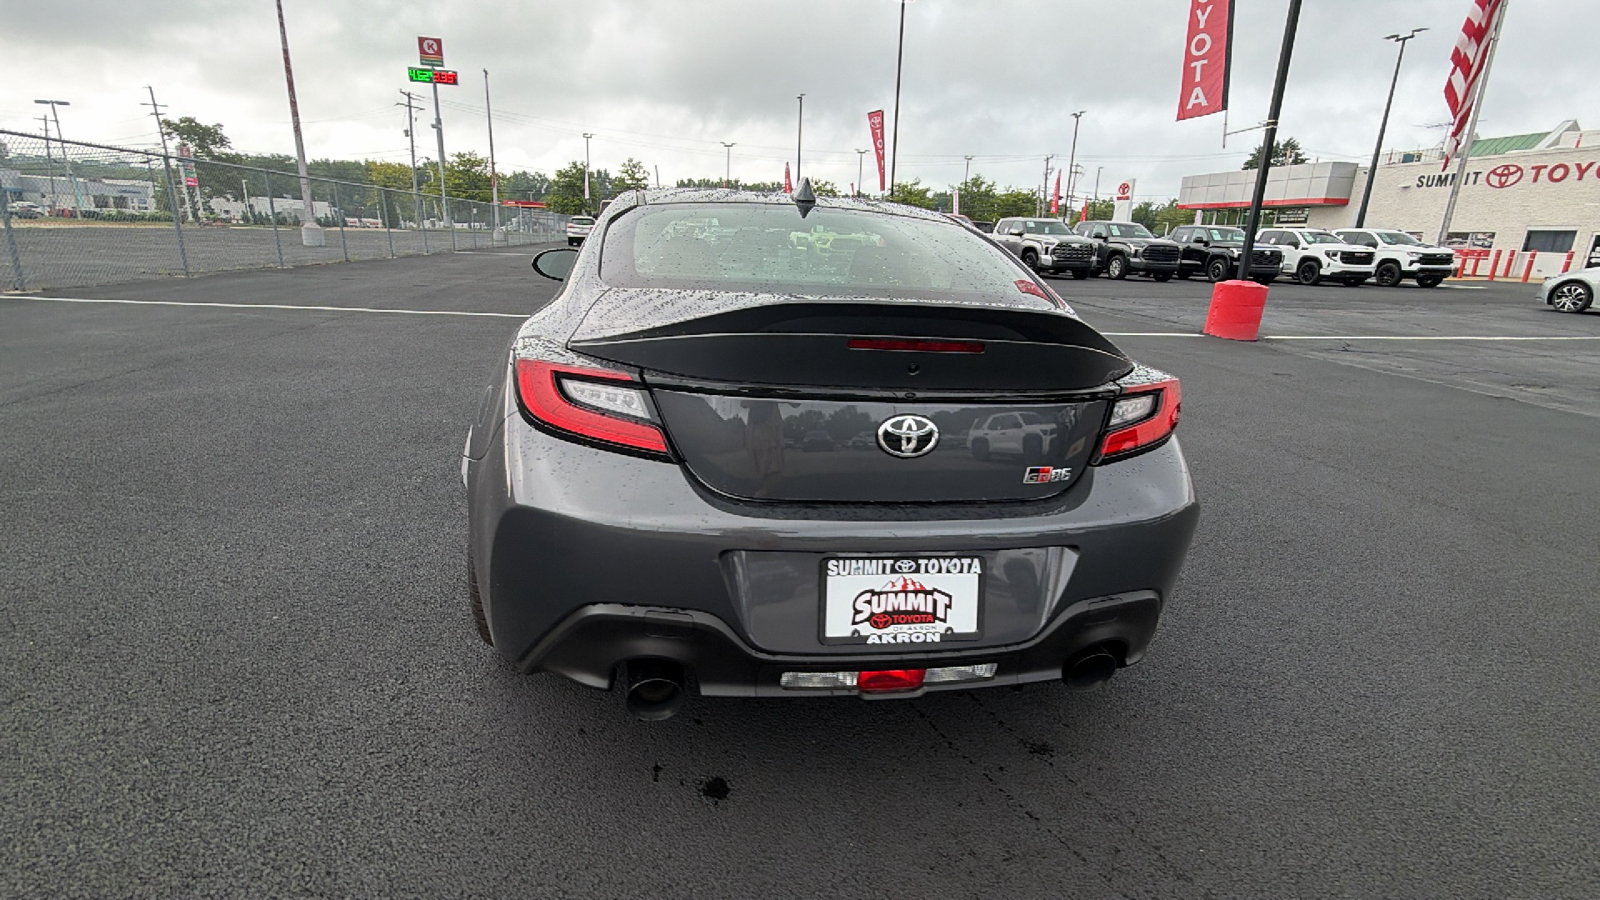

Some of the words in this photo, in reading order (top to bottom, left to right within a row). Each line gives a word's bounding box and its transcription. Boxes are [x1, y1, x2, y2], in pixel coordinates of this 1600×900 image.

[1186, 0, 1214, 110] YOTA
[1531, 161, 1600, 184] TOY
[827, 559, 894, 577] SUMMIT
[918, 558, 982, 575] TOYOTA
[854, 590, 951, 624] SUMMIT
[892, 614, 934, 624] TOYOTA
[866, 632, 941, 645] AKRON
